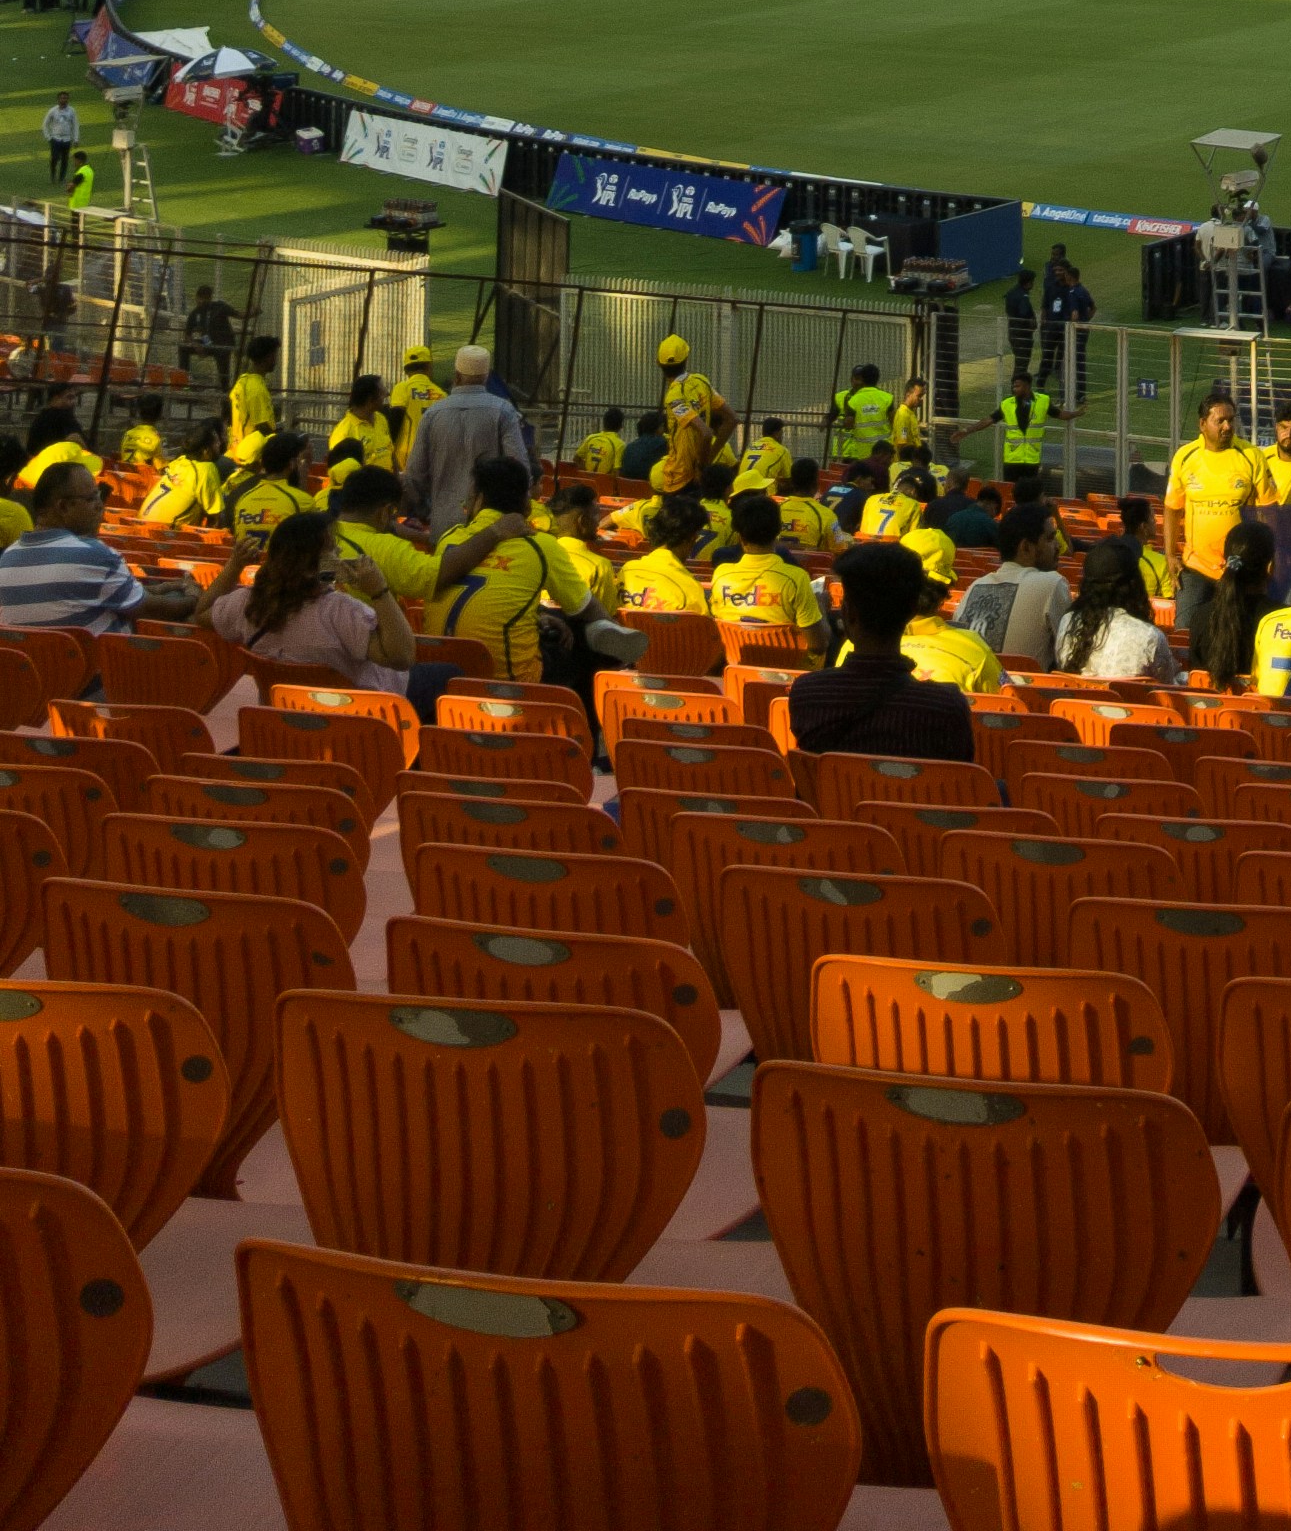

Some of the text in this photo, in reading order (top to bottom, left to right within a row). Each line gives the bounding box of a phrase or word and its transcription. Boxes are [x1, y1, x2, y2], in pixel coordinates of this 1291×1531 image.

[1042, 206, 1087, 221] AngelOne
[1140, 382, 1155, 396] 11
[747, 454, 762, 470] 7
[143, 483, 172, 516] 7
[880, 509, 896, 535] 7
[445, 574, 488, 637] 7
[722, 585, 782, 607] FedEx
